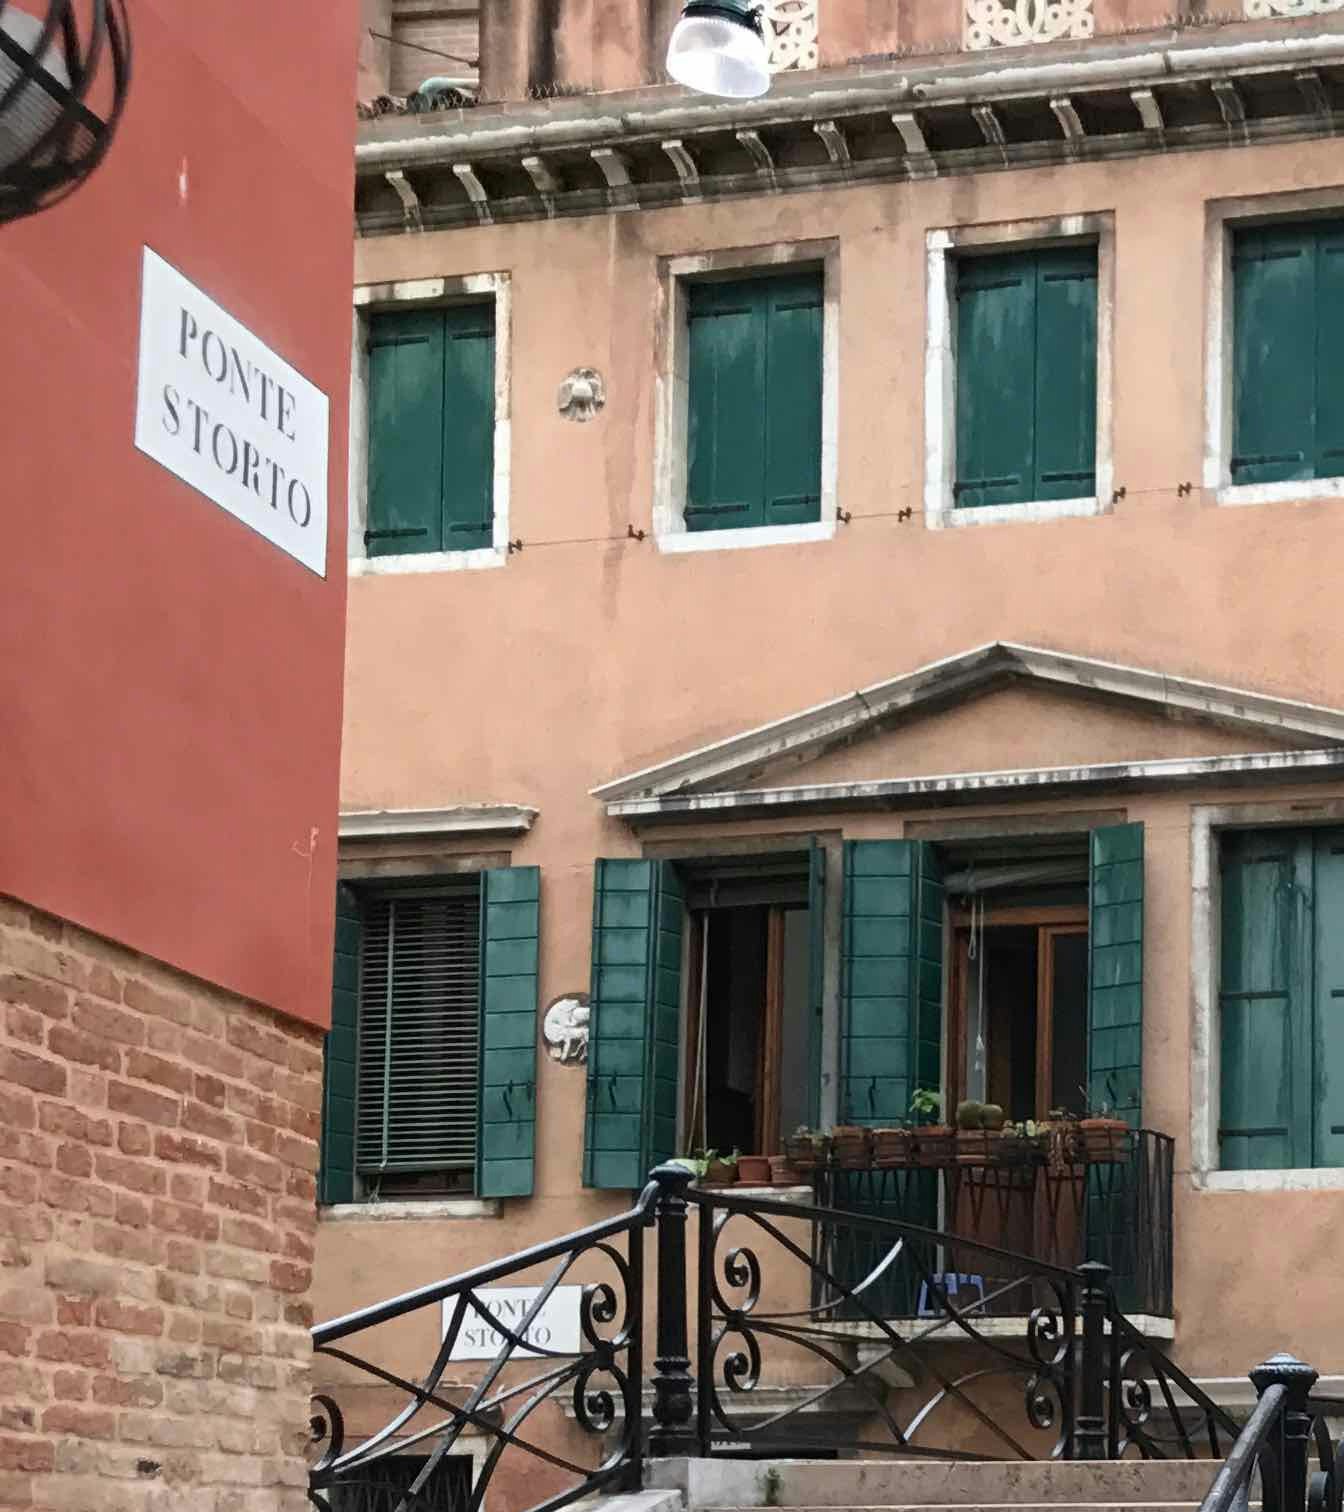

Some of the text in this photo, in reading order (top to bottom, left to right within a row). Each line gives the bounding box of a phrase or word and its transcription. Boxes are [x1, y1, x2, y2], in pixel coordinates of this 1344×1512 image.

[179, 308, 297, 441] PONTE
[162, 384, 312, 529] STORTO
[464, 1327, 551, 1347] STOTO
[472, 1298, 546, 1319] ONT
